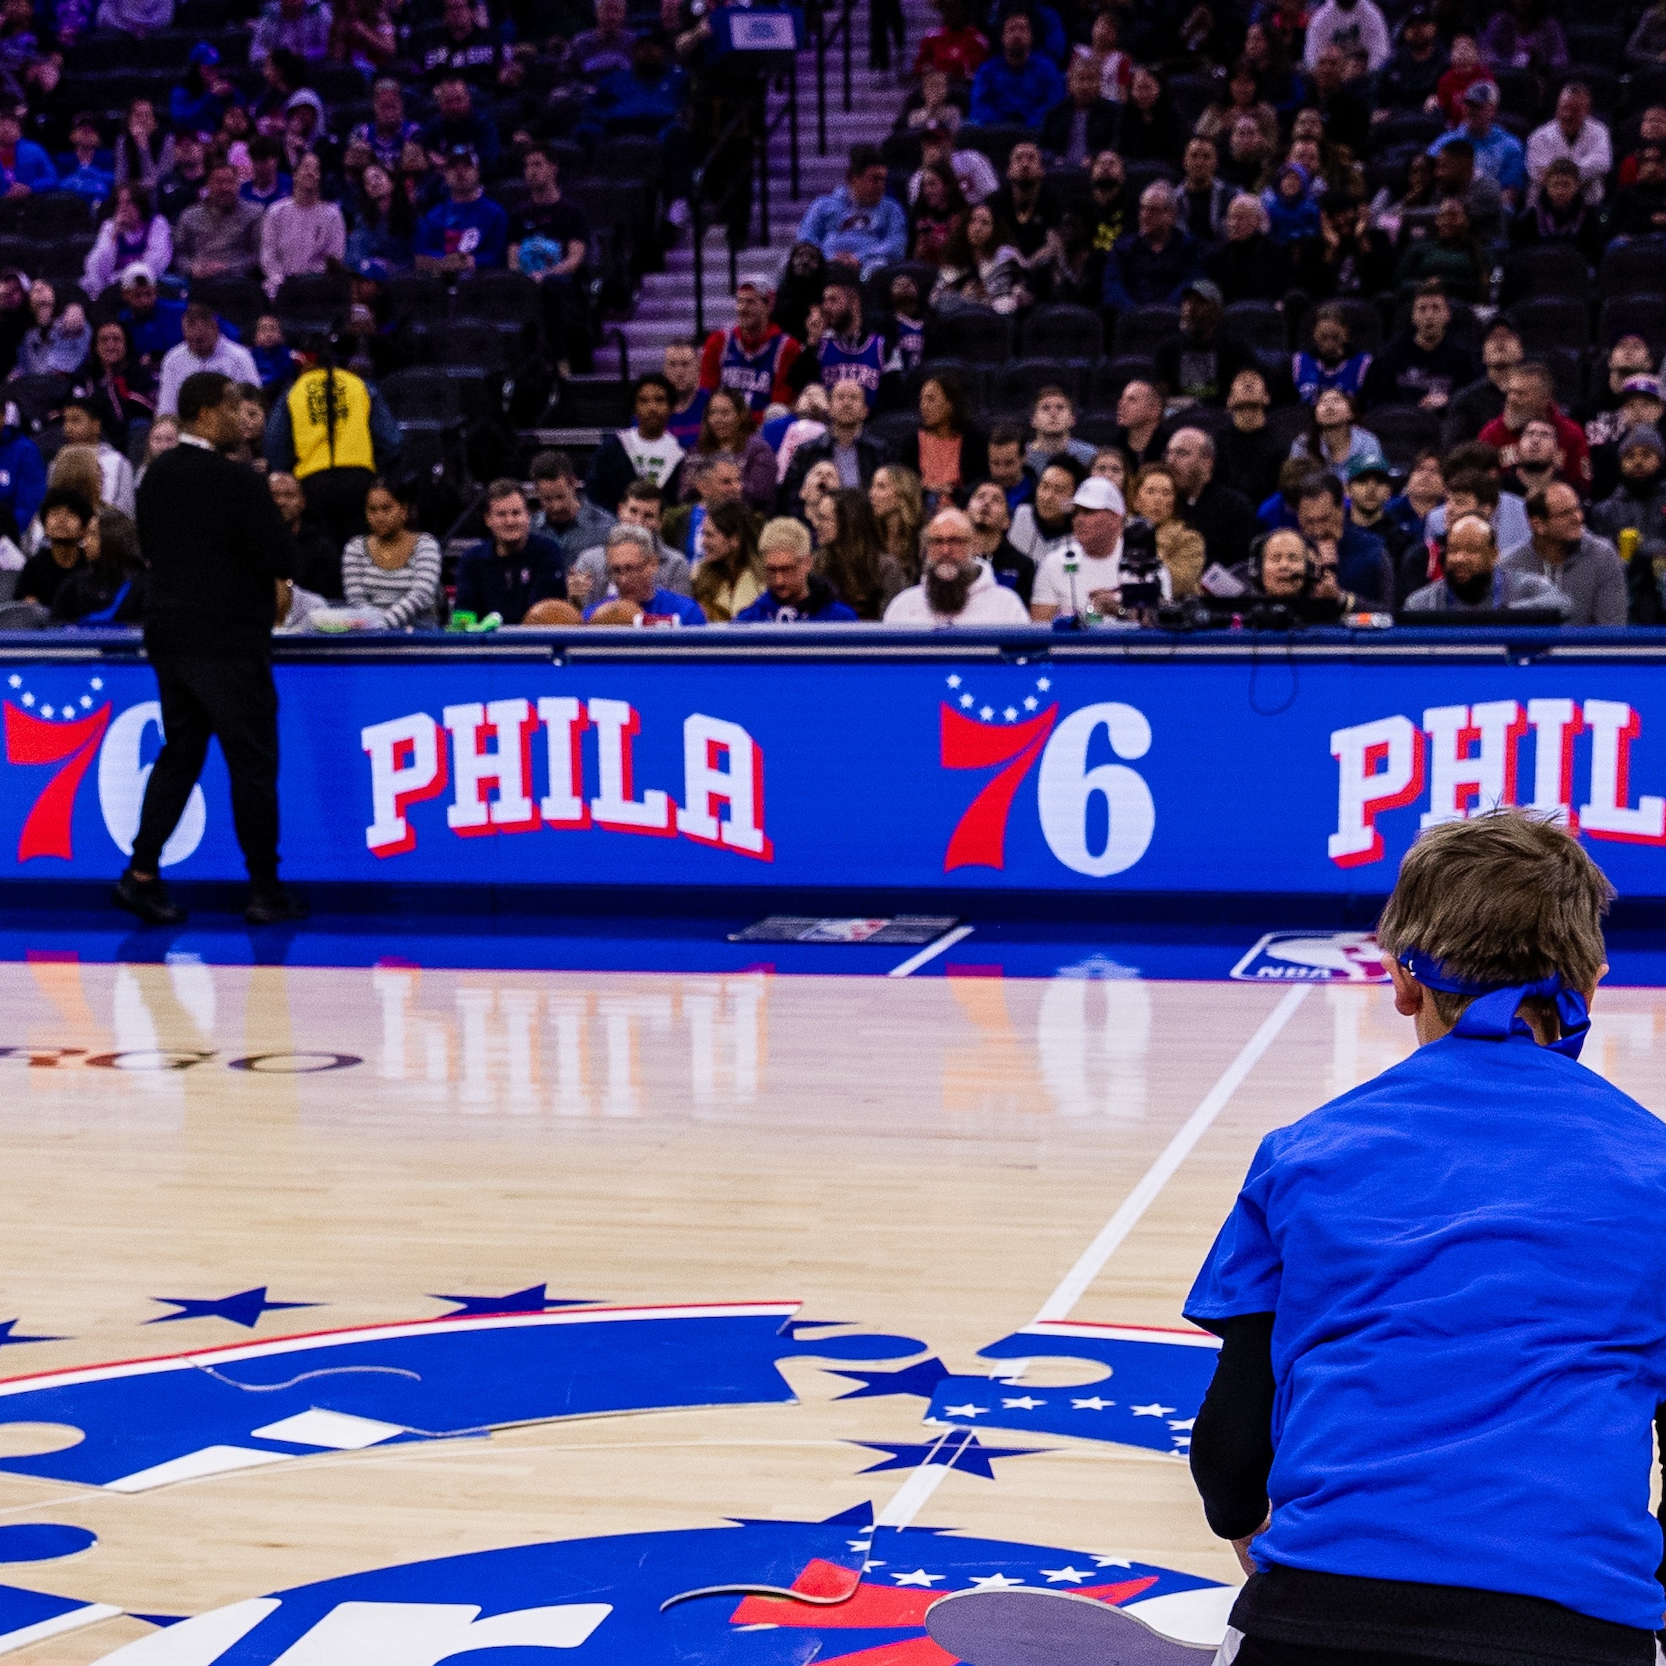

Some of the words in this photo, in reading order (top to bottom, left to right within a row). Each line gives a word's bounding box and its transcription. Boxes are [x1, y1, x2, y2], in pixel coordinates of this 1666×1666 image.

[362, 695, 775, 862] PHILA
[939, 700, 1156, 878] 76
[1257, 965, 1331, 979] NBA
